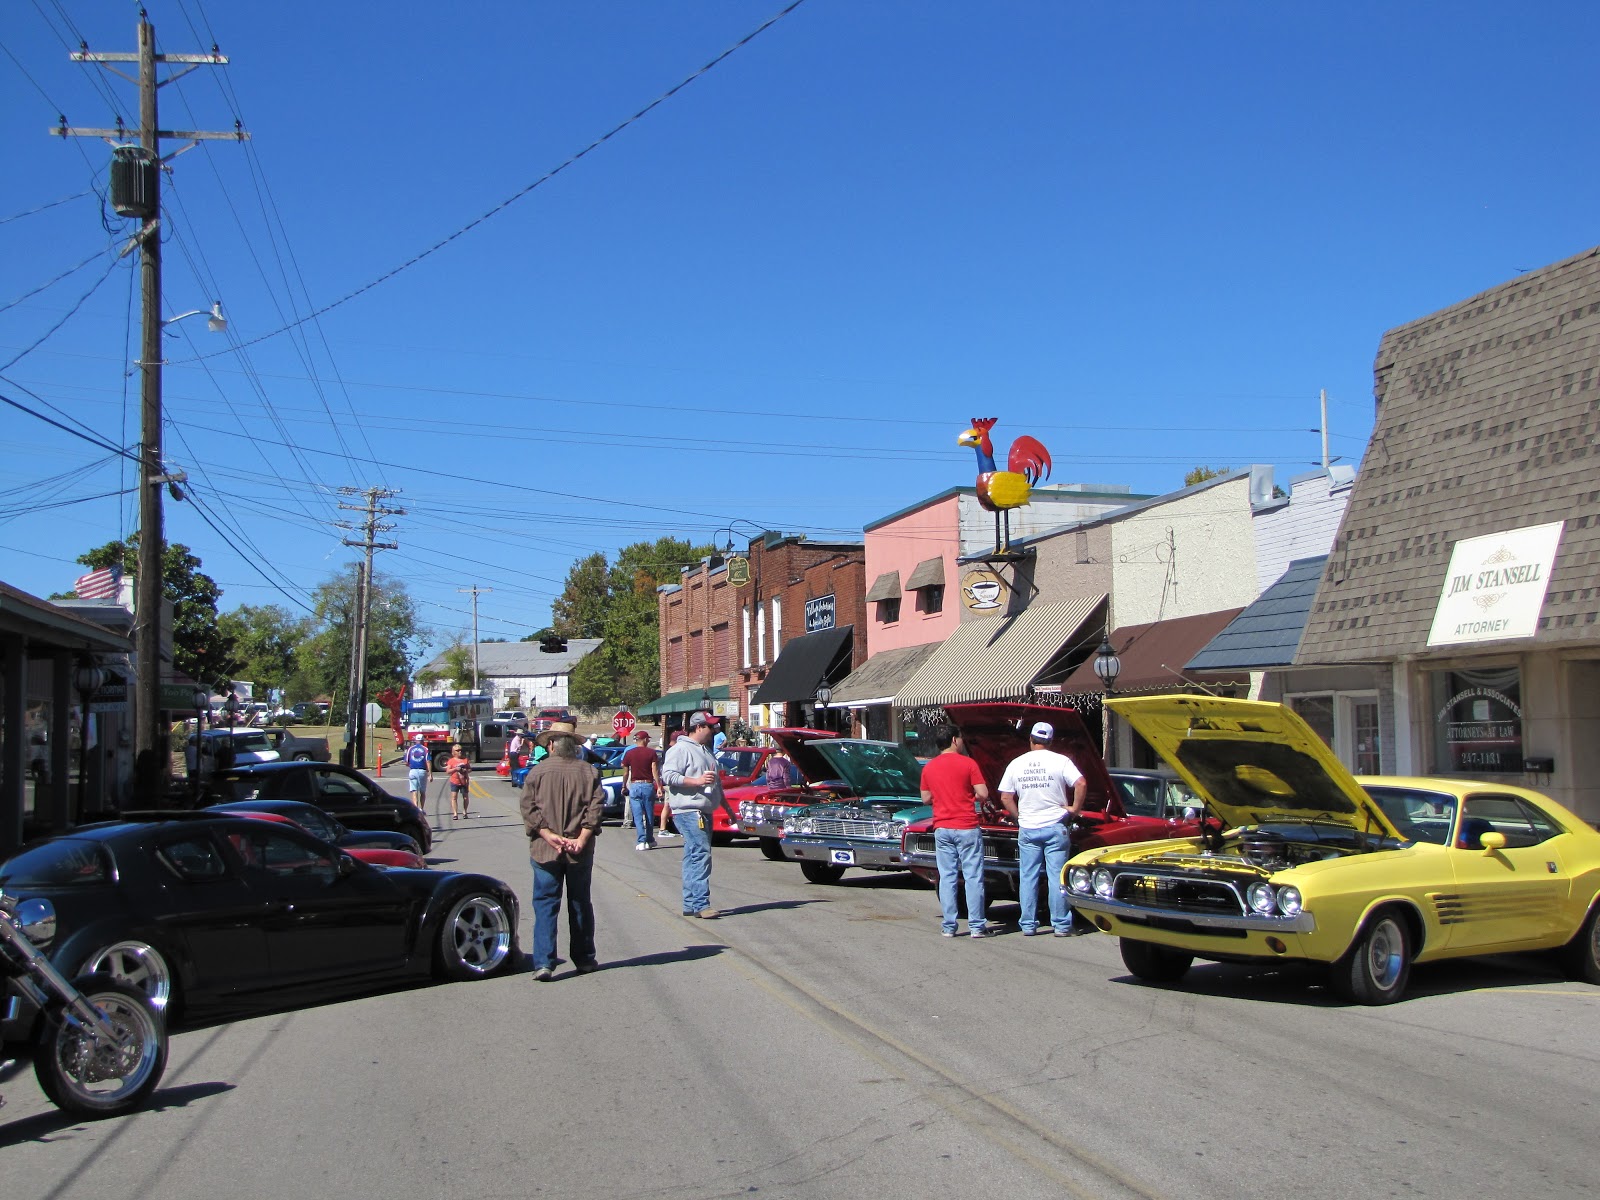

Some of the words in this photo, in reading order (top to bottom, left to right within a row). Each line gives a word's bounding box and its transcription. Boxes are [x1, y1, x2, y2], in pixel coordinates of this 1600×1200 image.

[1448, 574, 1472, 596] JIM
[1475, 563, 1541, 590] STANSELL
[1454, 618, 1510, 636] ATTORNEY
[1437, 707, 1447, 722] JIM
[1446, 688, 1475, 710] STANSELL
[1476, 687, 1482, 696] &
[1483, 687, 1522, 718] ASSOCIATES
[614, 718, 635, 728] STOP
[1499, 725, 1514, 738] LAW
